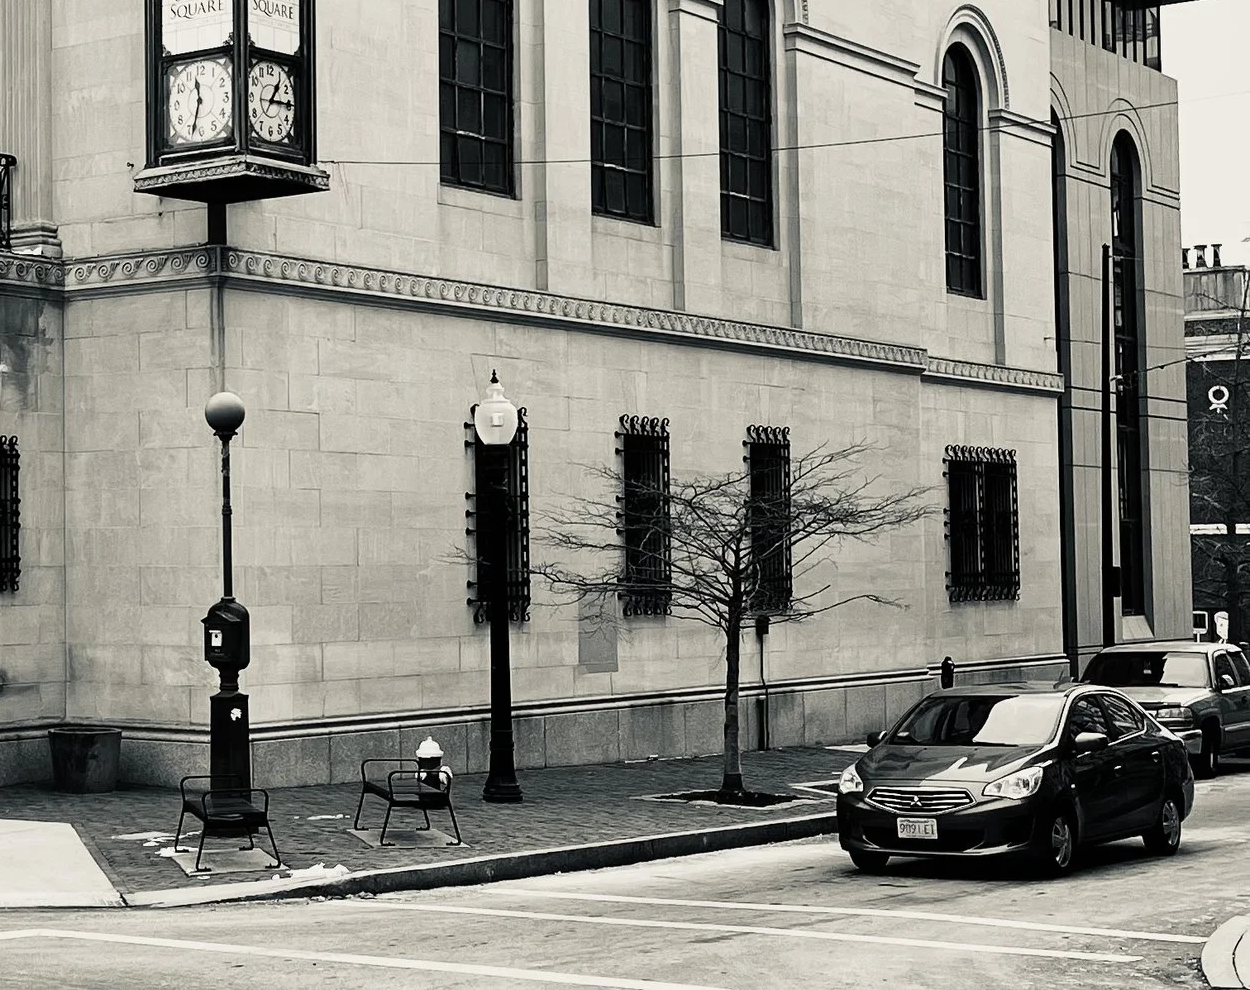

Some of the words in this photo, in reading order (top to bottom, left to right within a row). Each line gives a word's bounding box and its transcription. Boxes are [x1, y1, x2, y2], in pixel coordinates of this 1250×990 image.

[196, 65, 206, 76] 12
[211, 67, 215, 78] 1
[259, 67, 264, 78] 11
[266, 65, 274, 77] 12
[186, 71, 192, 82] 11
[251, 75, 259, 87] 10
[219, 77, 226, 88] 2
[177, 83, 186, 94] 10
[283, 84, 289, 95] 2
[222, 91, 230, 103] 3
[249, 92, 255, 103] 9
[174, 100, 180, 111] 9
[219, 108, 226, 118] 4
[252, 108, 258, 118] 8
[177, 114, 184, 125] 8
[284, 114, 290, 126] 4
[187, 124, 192, 135] 7
[210, 120, 217, 131] 5
[259, 121, 264, 131] 7
[276, 123, 283, 135] 5
[198, 126, 205, 137] 6
[268, 126, 274, 137] 6
